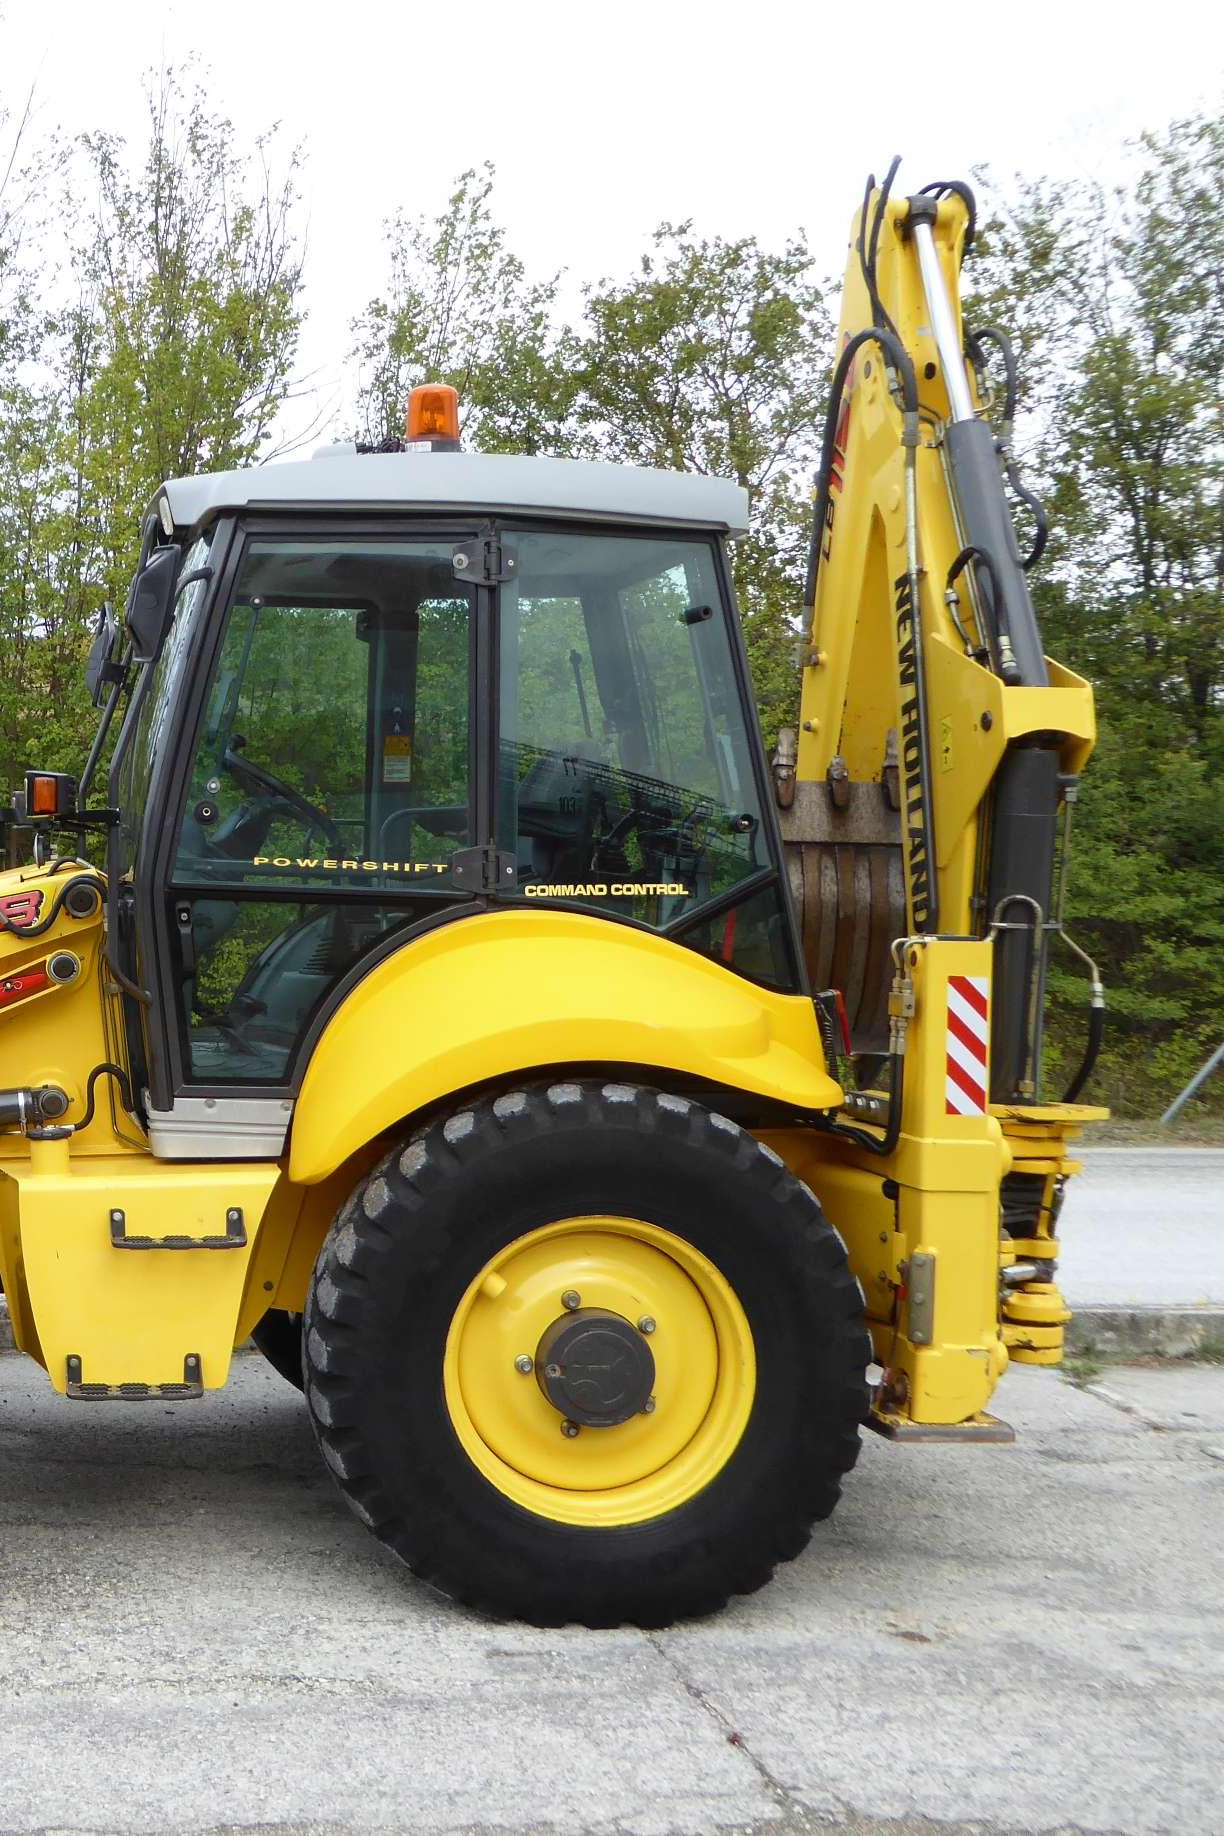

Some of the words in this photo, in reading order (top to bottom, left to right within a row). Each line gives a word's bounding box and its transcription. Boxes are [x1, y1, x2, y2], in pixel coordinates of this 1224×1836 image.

[895, 571, 919, 687] NEW
[902, 697, 930, 934] HOLLAND
[253, 856, 448, 874] POWERSHIFT
[524, 884, 607, 897] COMMAND
[610, 883, 689, 896] CONTROL
